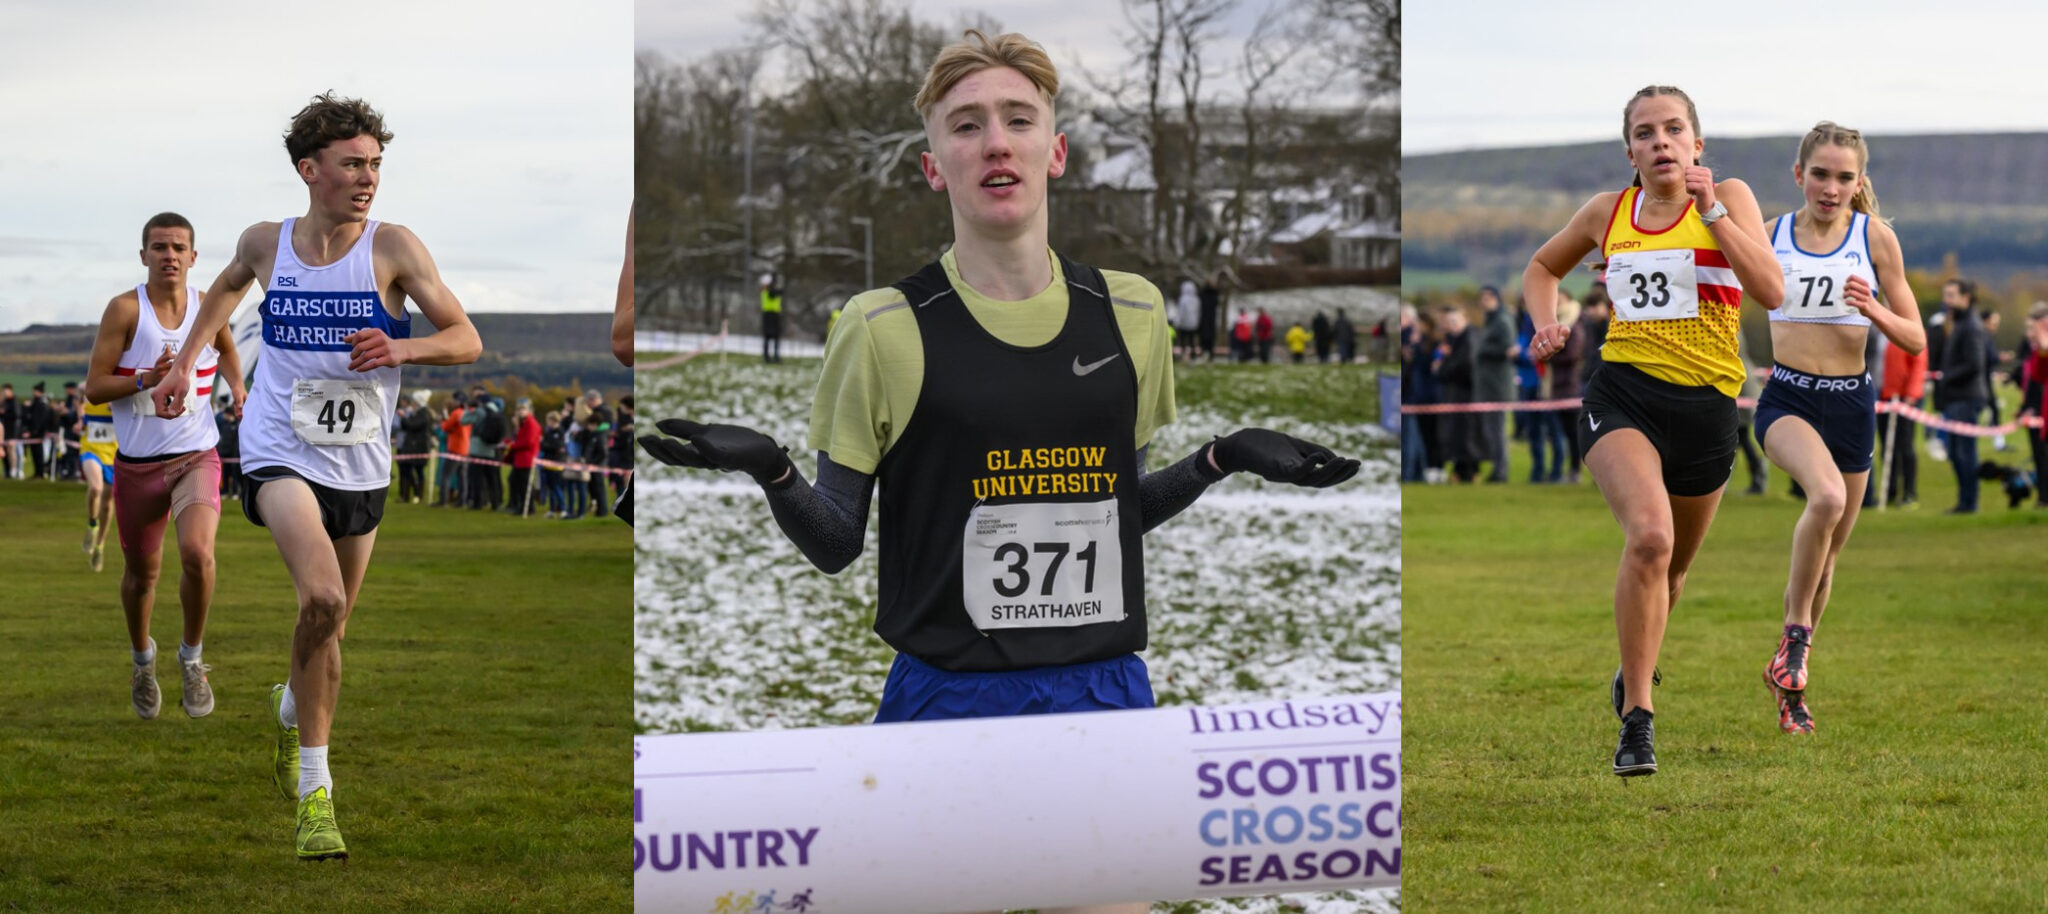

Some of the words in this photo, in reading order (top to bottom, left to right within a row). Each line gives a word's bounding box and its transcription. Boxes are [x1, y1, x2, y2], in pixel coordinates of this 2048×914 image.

[278, 276, 299, 287] PSL
[1630, 271, 1670, 309] 33
[1799, 276, 1834, 308] 72
[270, 297, 374, 318] GARSCUBE
[273, 325, 372, 345] HARRIE
[1771, 364, 1813, 389] NIKE
[1814, 378, 1860, 392] PRO
[317, 399, 355, 434] 49
[986, 447, 1107, 471] GLASGOW
[972, 473, 1118, 499] UNIVERSITY
[992, 541, 1097, 598] 371
[991, 600, 1102, 620] STRATHAVEN
[1189, 701, 1401, 735] lindsay
[1197, 752, 1401, 799] SCOTTIS
[1199, 800, 1401, 847] CROSSC
[1199, 847, 1401, 886] SEASON
